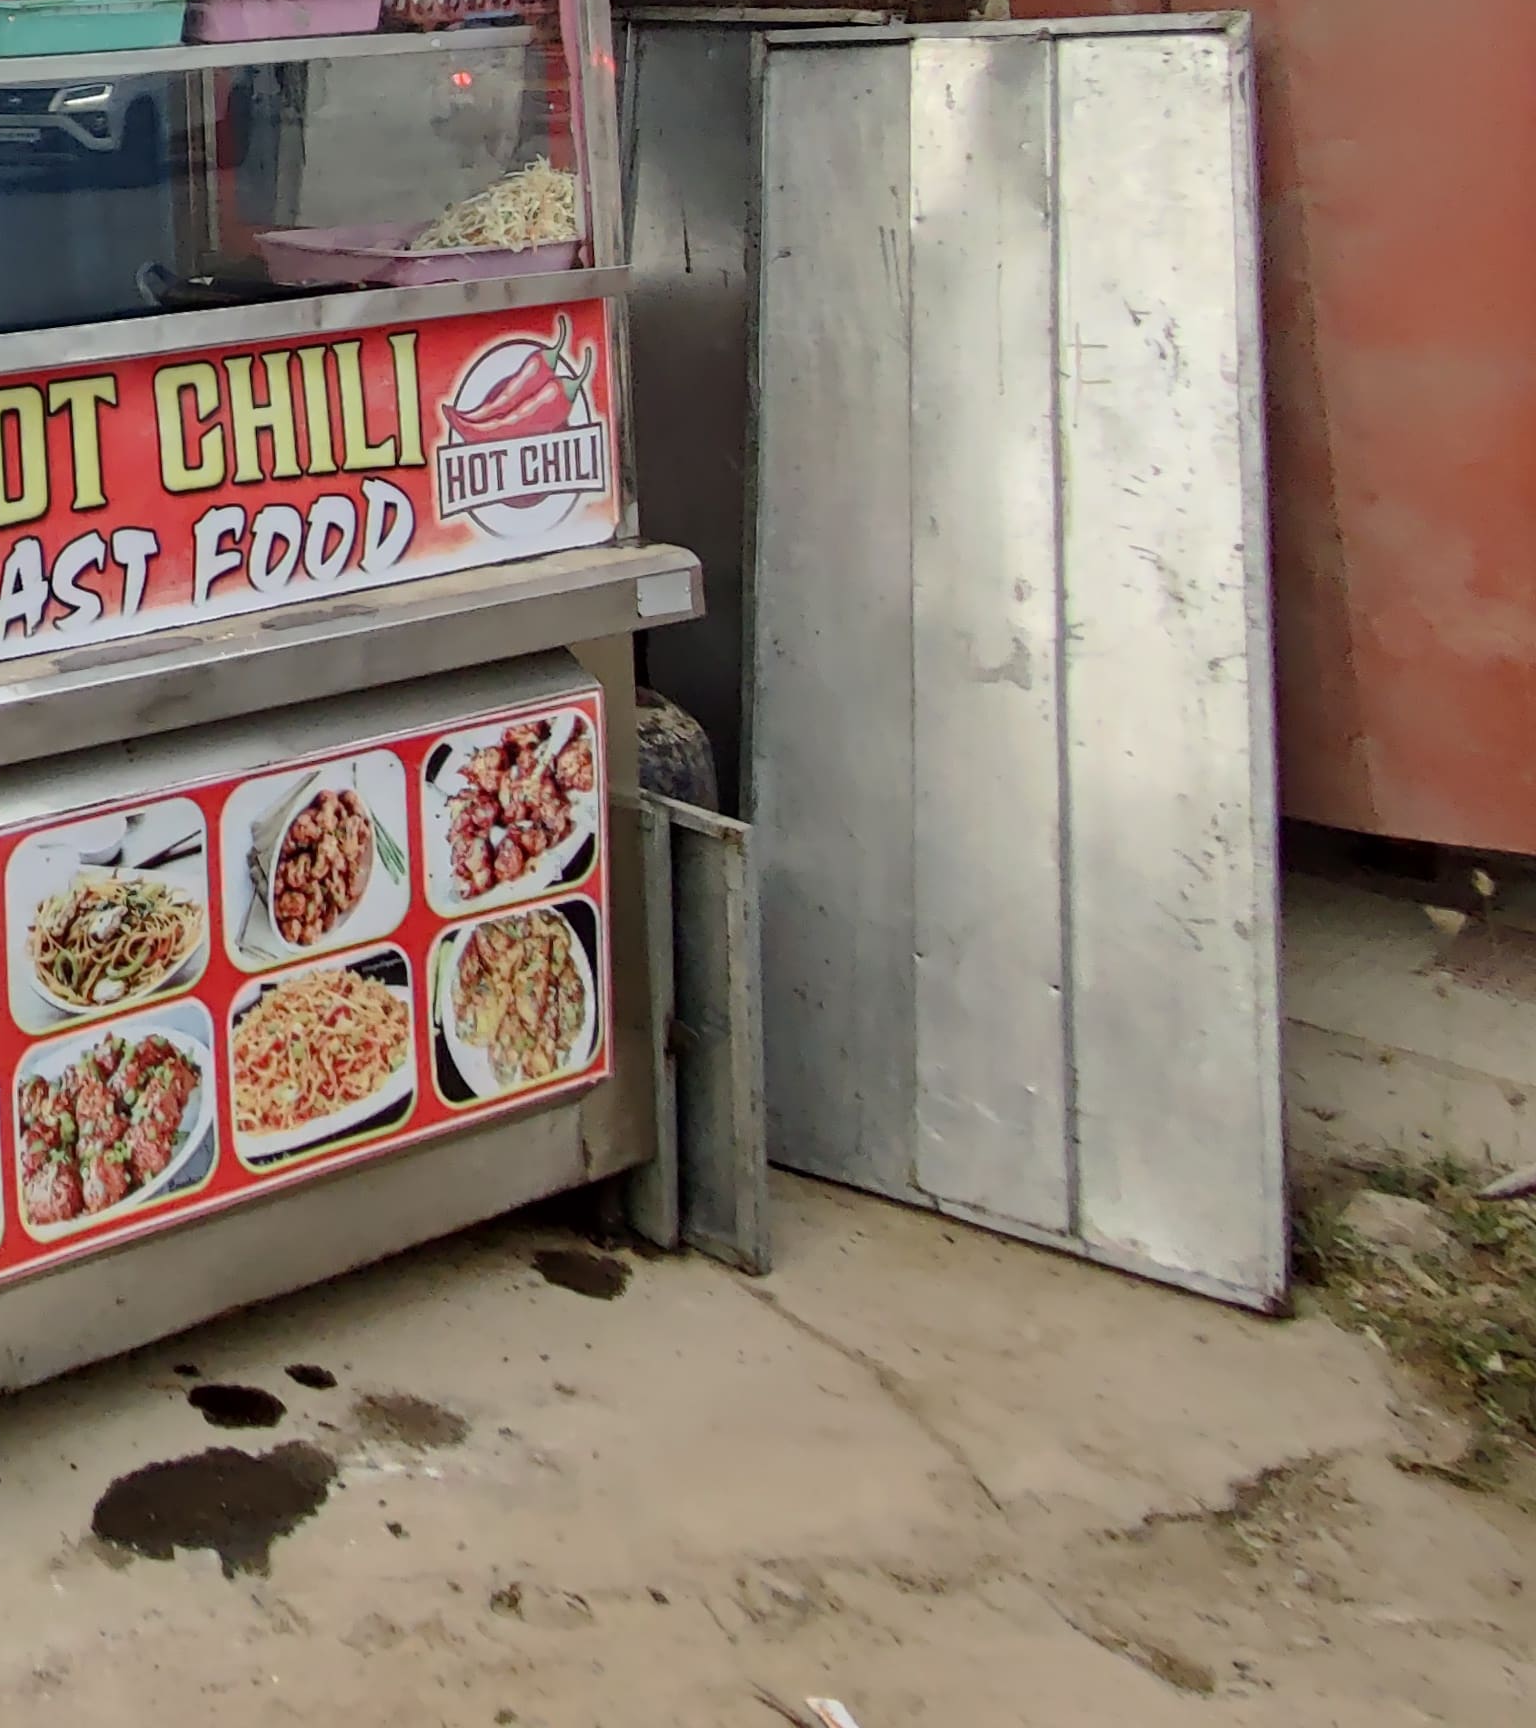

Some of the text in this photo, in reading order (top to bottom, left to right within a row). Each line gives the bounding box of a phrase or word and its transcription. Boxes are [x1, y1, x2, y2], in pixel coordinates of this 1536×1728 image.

[151, 332, 426, 495] CHILI
[445, 434, 599, 505] HOT CHILI
[192, 477, 416, 609] FOOD
